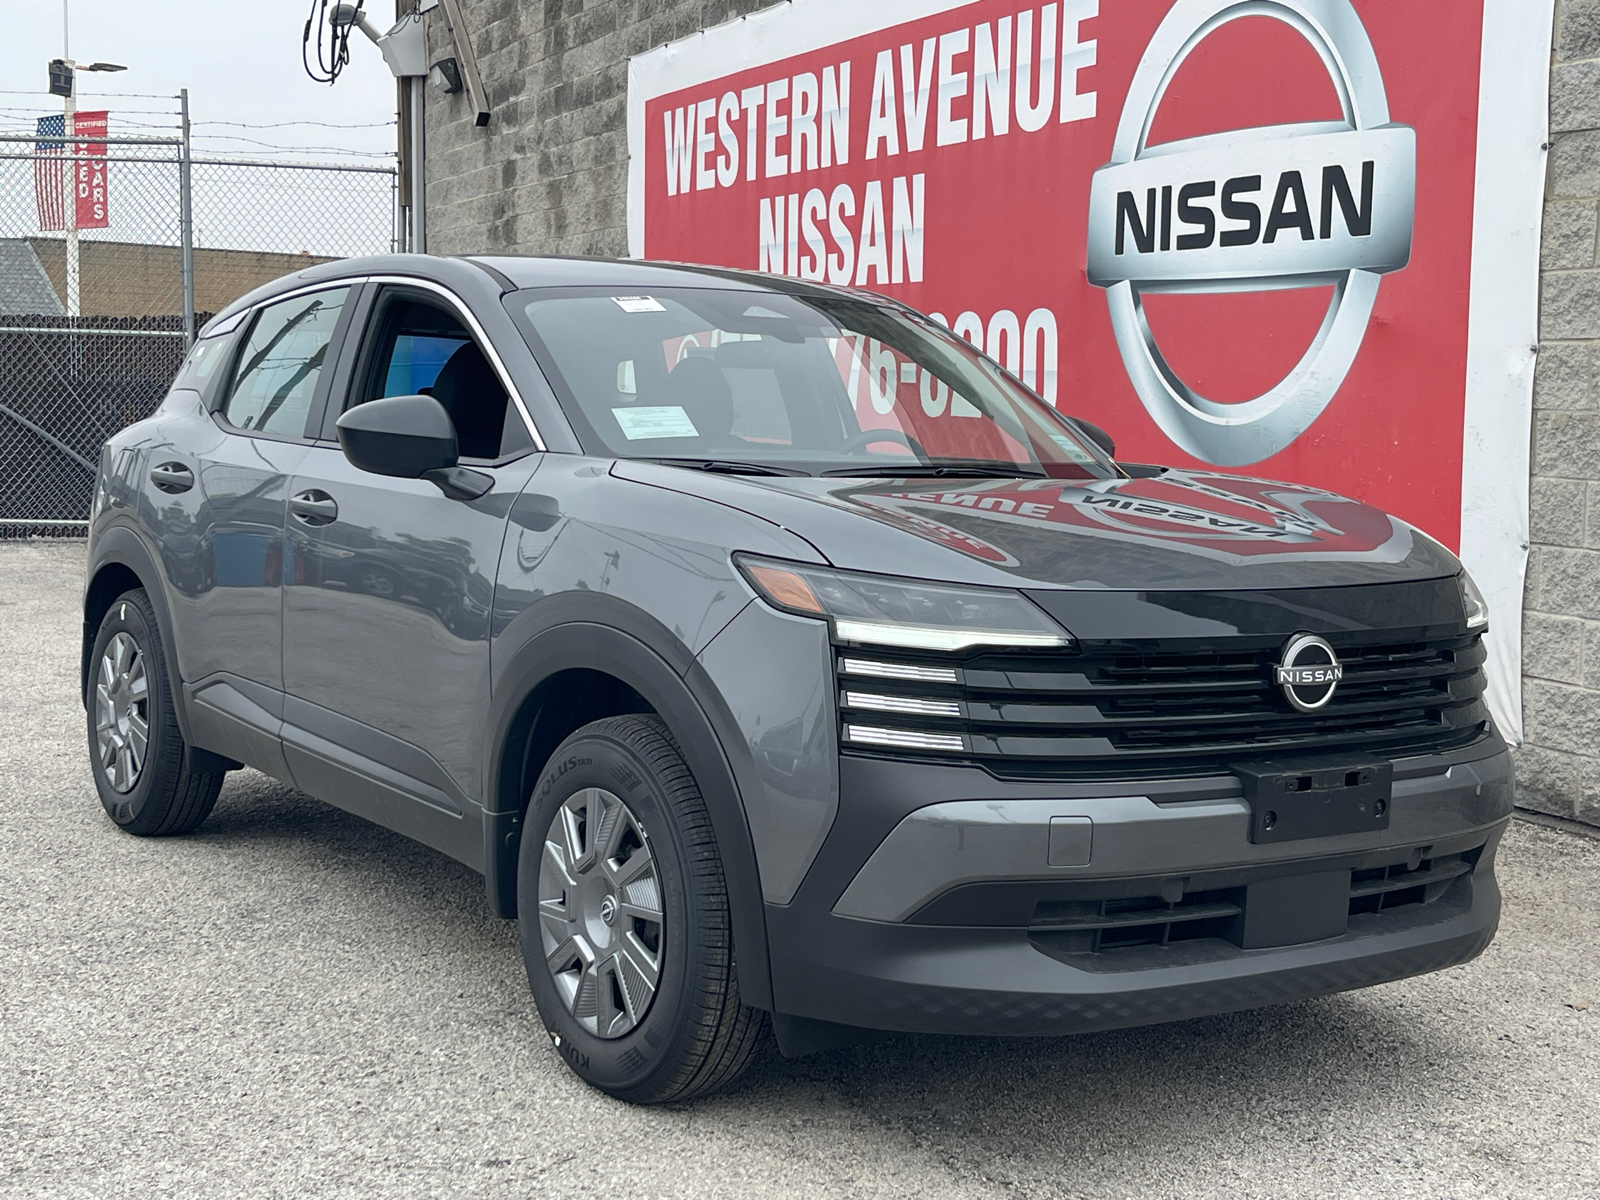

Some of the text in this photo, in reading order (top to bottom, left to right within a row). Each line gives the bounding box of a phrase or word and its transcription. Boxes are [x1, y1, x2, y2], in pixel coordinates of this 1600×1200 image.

[75, 120, 107, 129] CERTIFIED
[664, 0, 1099, 196] WESTERN AVENUE
[92, 157, 105, 219] CARS
[1114, 160, 1375, 256] NISSAN
[759, 173, 926, 286] NISSAN
[1280, 667, 1342, 682] NISSAN
[535, 756, 577, 810] SOLUS
